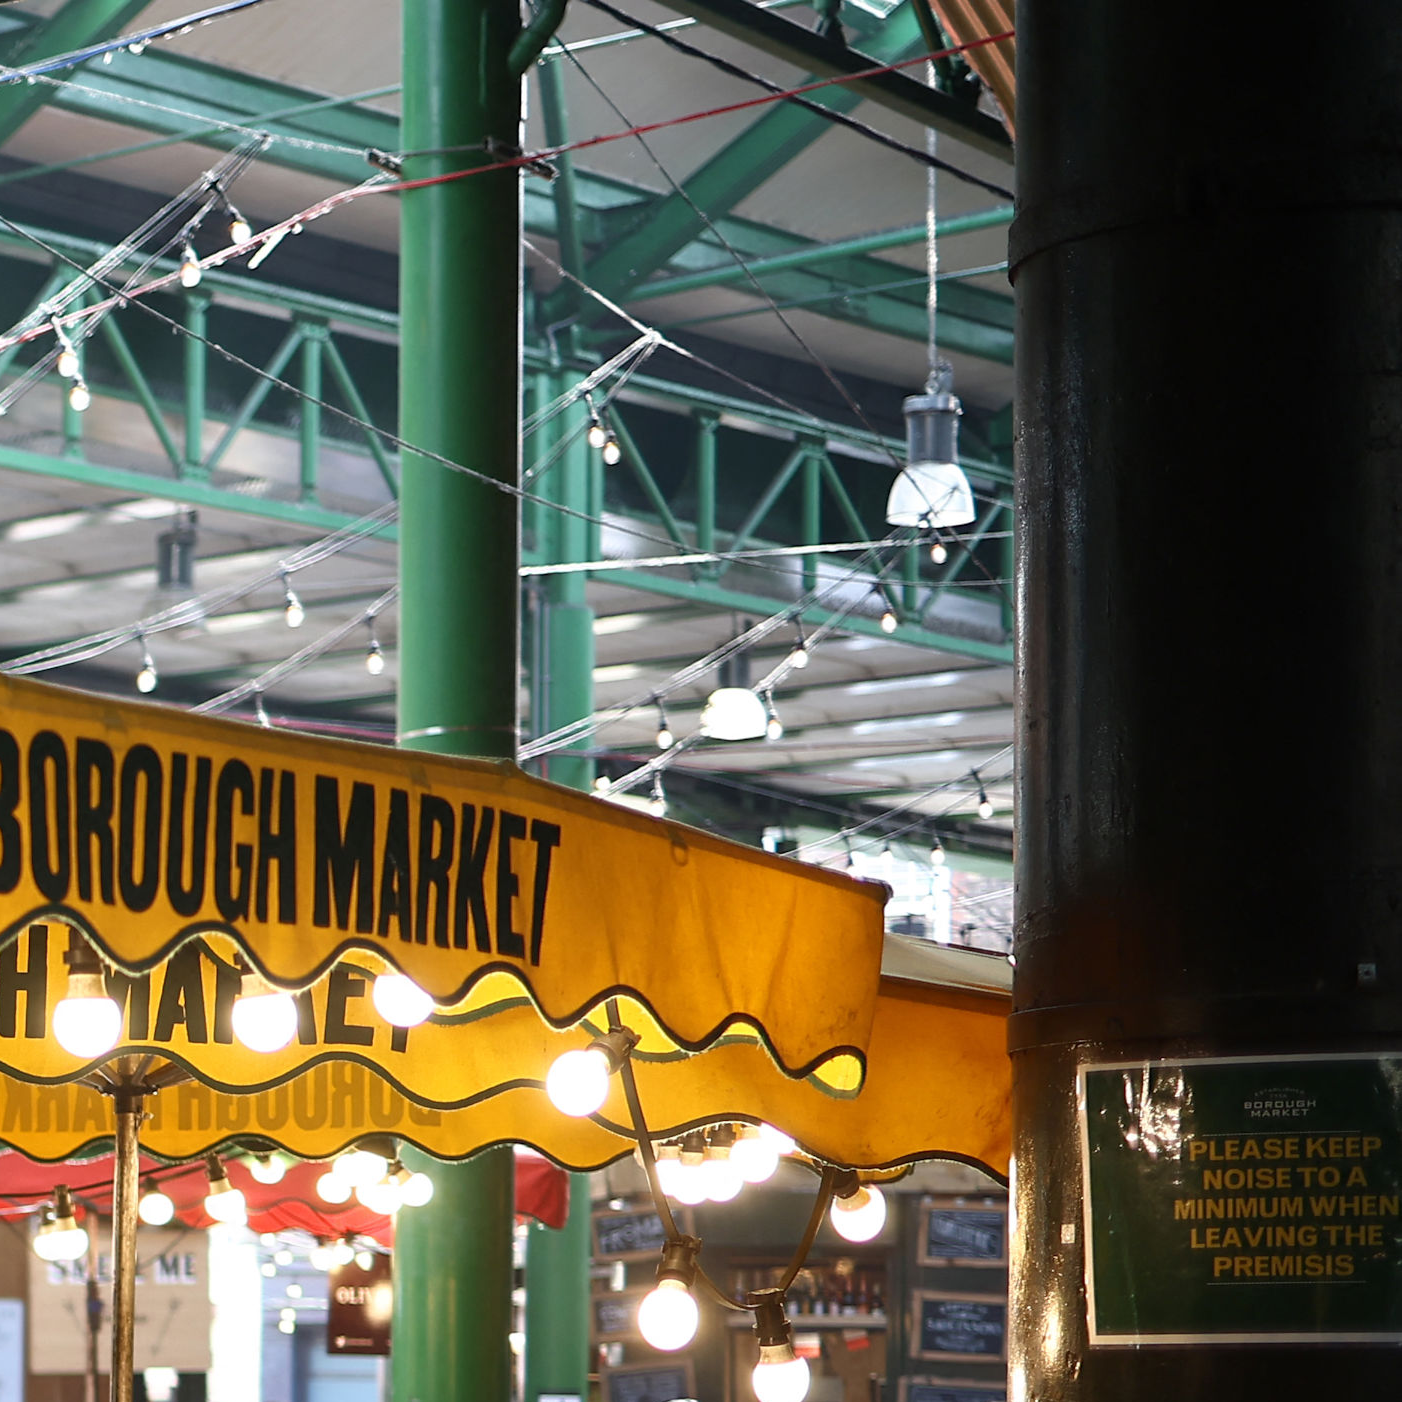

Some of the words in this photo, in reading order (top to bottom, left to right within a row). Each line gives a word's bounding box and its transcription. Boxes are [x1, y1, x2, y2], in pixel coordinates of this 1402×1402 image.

[313, 774, 561, 967] MARKET
[1244, 1100, 1316, 1109] BOROUGH
[1251, 1109, 1309, 1118] MARKET
[1189, 1138, 1300, 1161] PLEASE
[1306, 1136, 1382, 1158] KEEP
[1203, 1168, 1292, 1190] NOISE
[1297, 1167, 1341, 1188] TO
[1347, 1166, 1368, 1187] A
[1174, 1197, 1303, 1220] MINIMUM
[1309, 1195, 1399, 1217] WHEN
[1190, 1225, 1318, 1249] LEAVING
[1322, 1225, 1384, 1246] THE
[1213, 1254, 1355, 1278] PREMISIS
